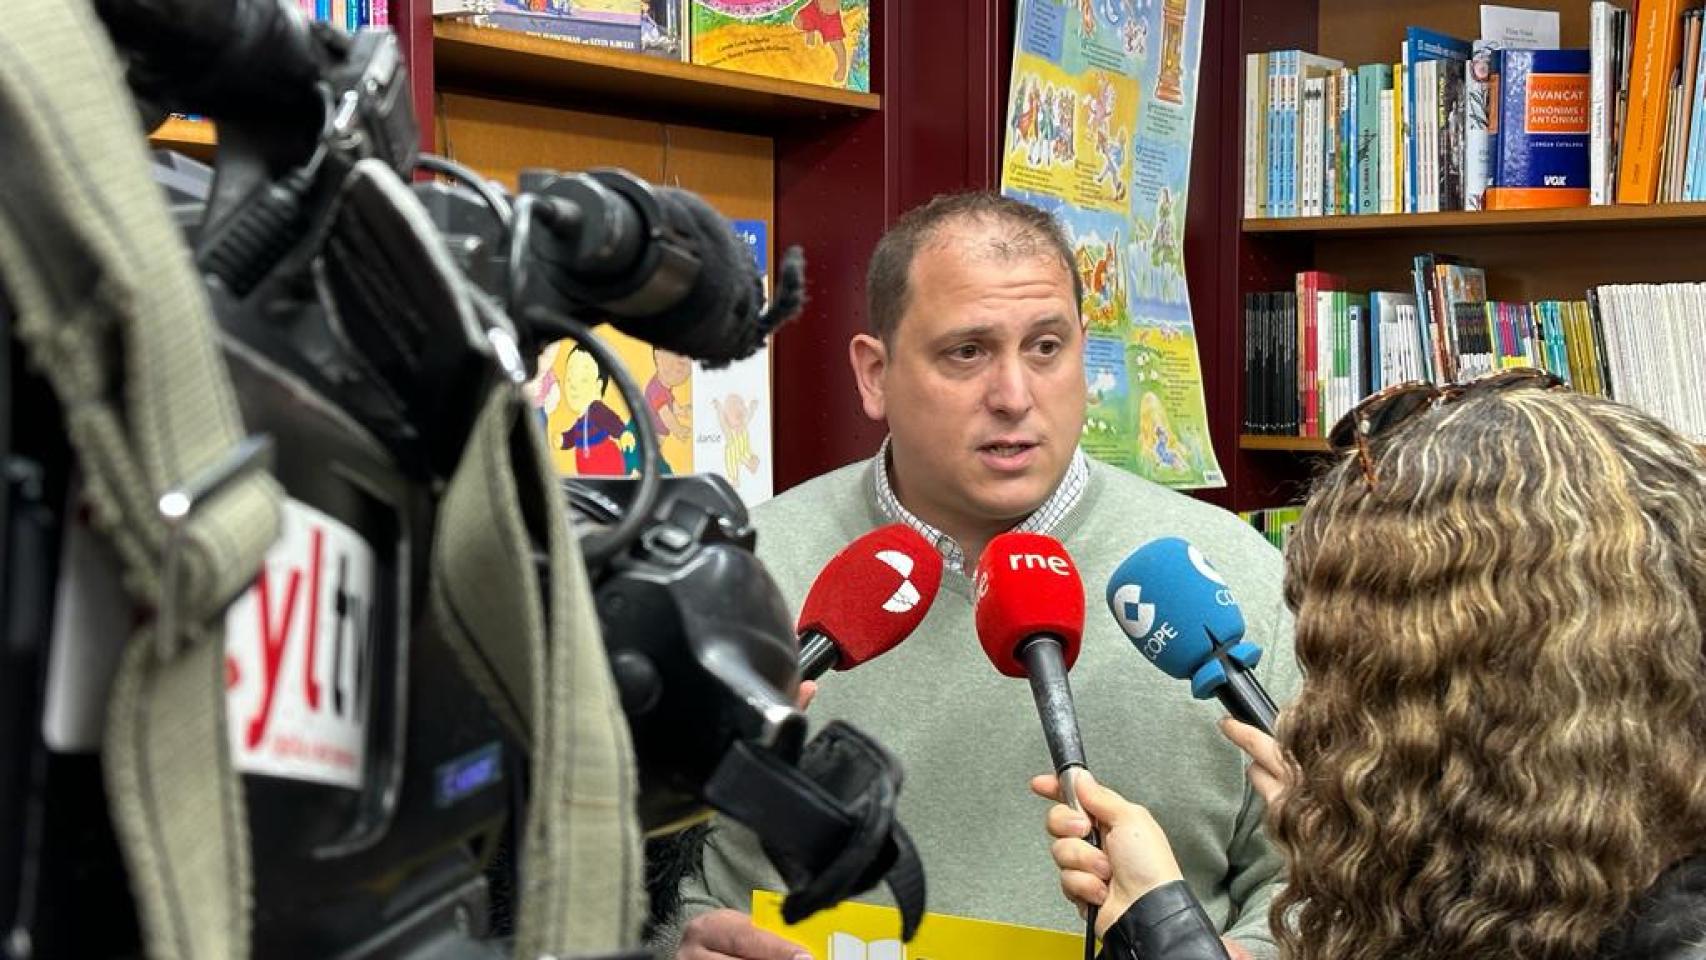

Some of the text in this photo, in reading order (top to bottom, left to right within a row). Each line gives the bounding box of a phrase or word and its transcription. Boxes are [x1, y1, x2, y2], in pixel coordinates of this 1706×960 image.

[1530, 90, 1585, 102] AVANÇAT
[1543, 174, 1567, 186] VOX
[1009, 553, 1070, 576] rne
[1144, 621, 1178, 661] COPE
